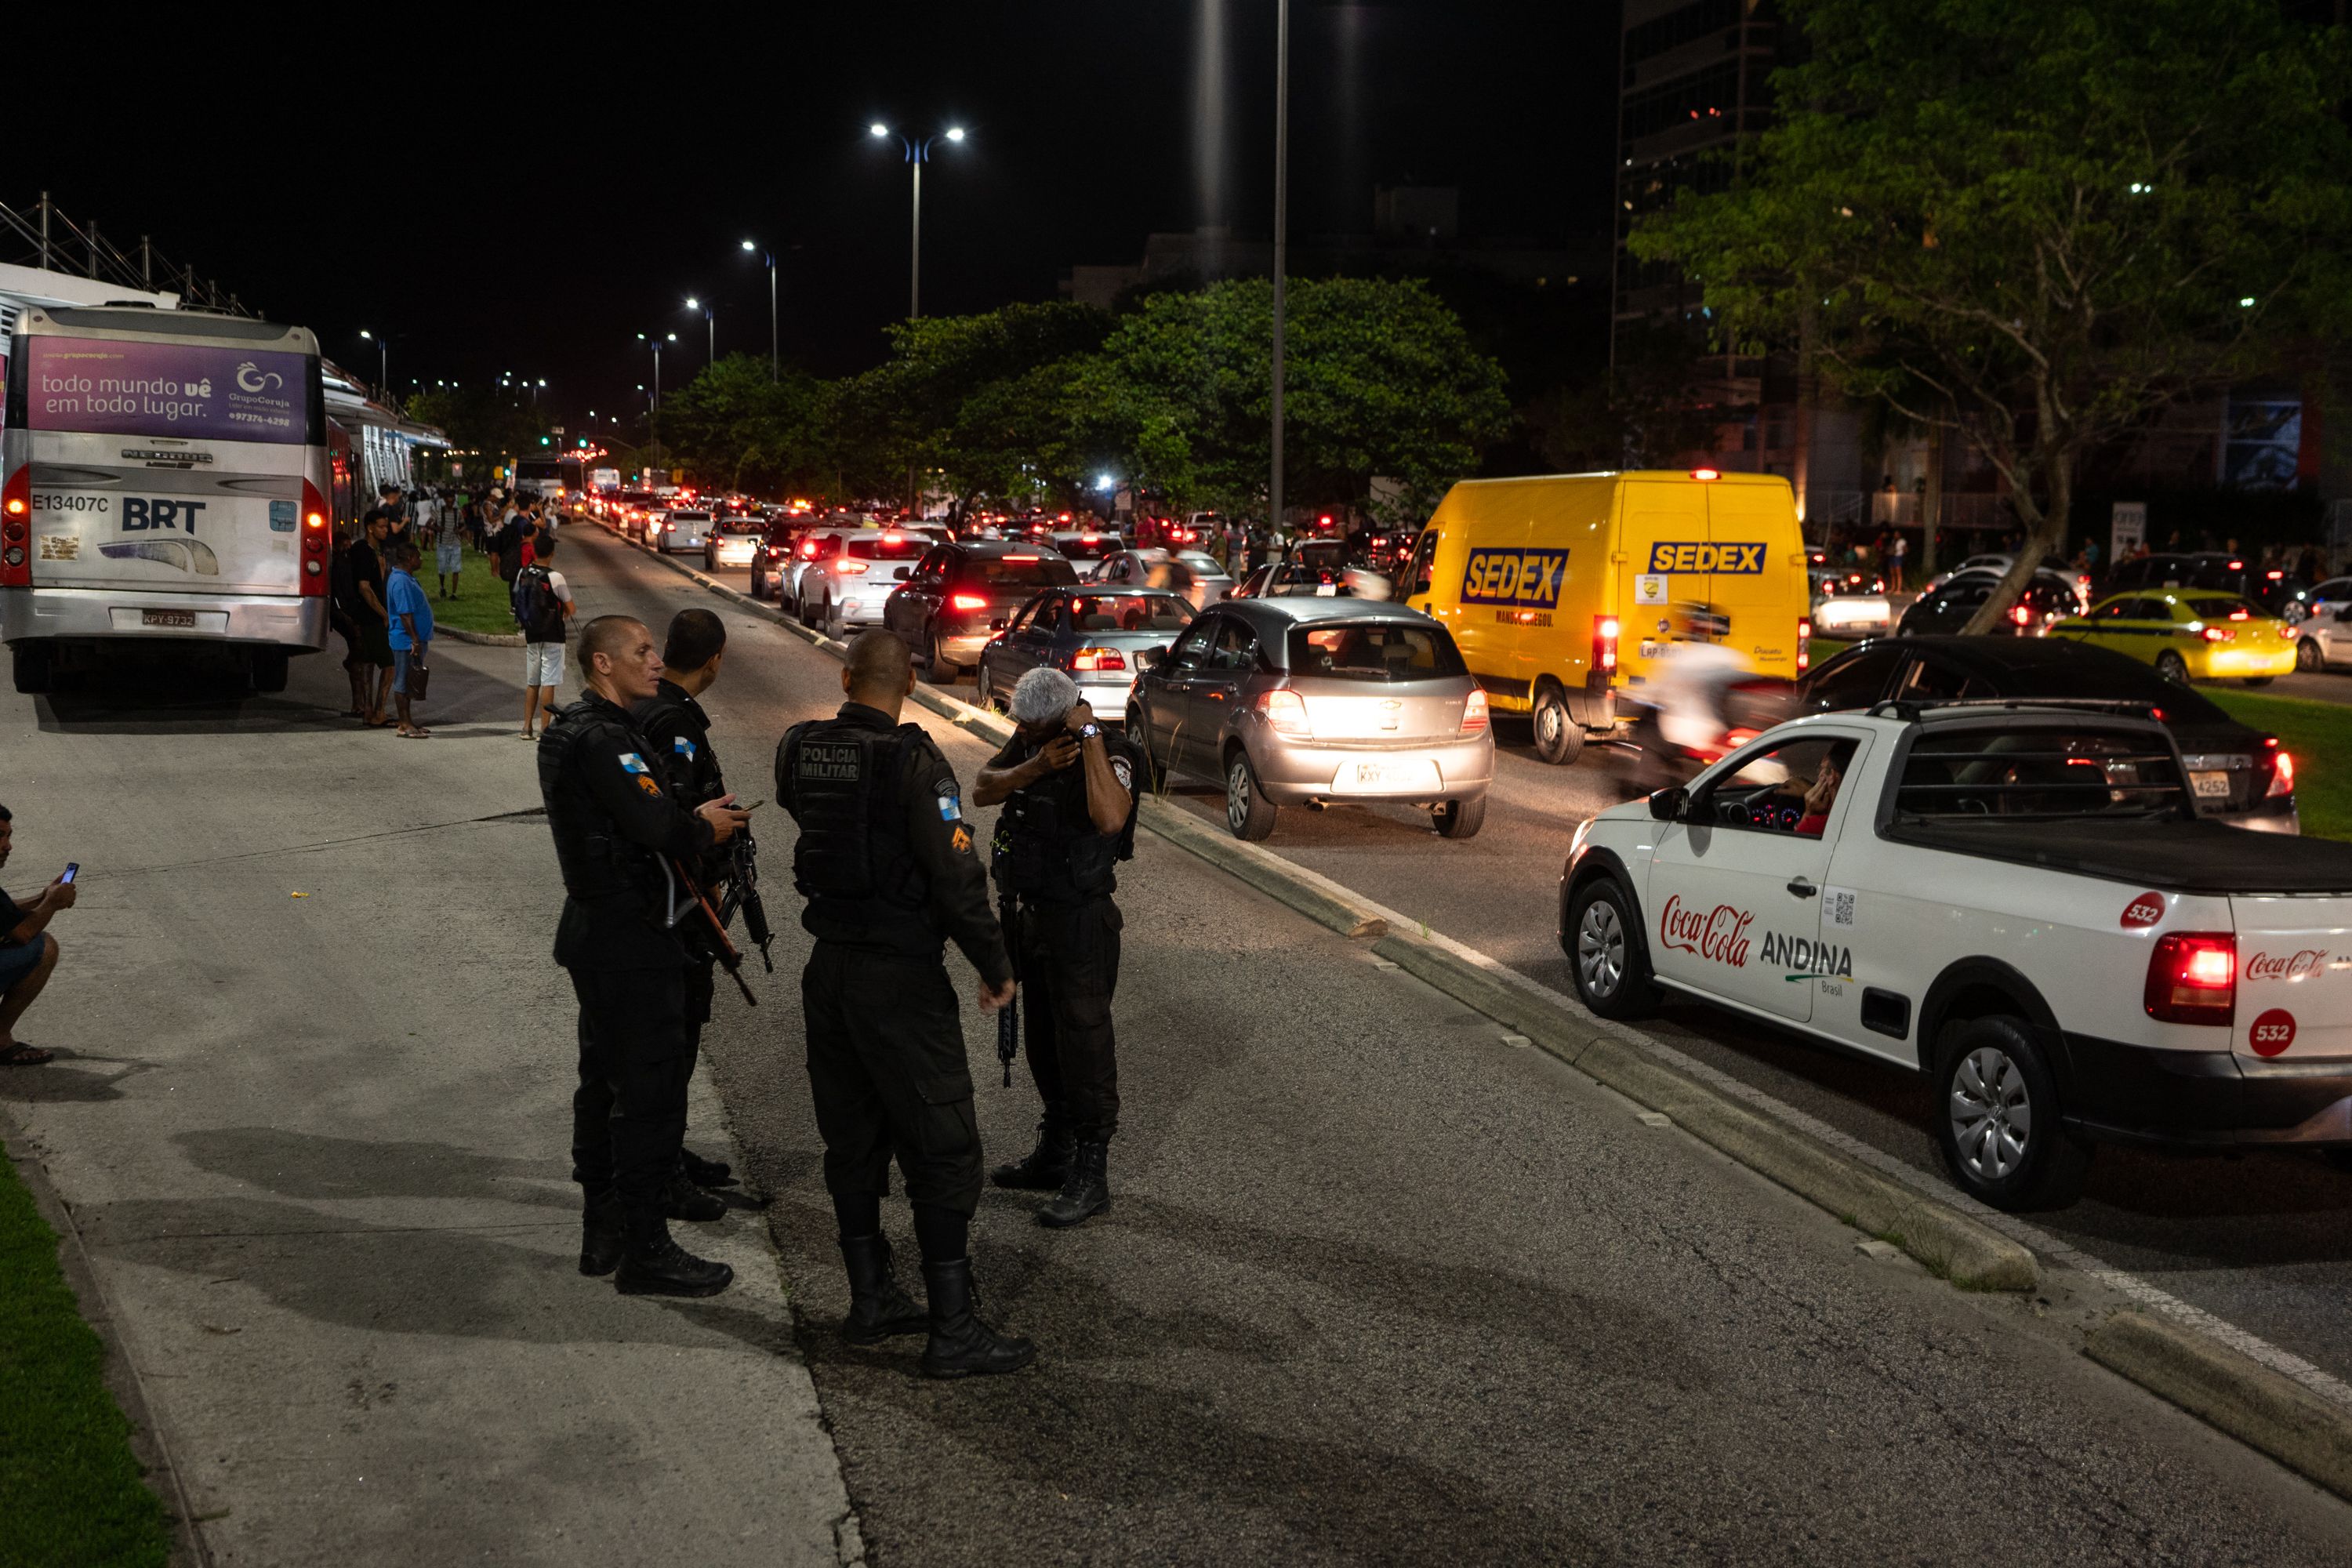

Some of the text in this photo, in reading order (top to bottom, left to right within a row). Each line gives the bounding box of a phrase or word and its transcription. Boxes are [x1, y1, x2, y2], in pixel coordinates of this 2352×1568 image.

[42, 374, 212, 398] todo mundo vê
[45, 394, 207, 421] em todo lugar.
[229, 393, 290, 408] GrupoCoruja
[235, 412, 290, 426] 97374-4298
[32, 495, 109, 513] E13407C
[122, 497, 206, 535] BRT
[1653, 544, 1762, 572] SEDEX
[1465, 554, 1563, 602] SEDEX
[802, 746, 857, 763] POLÍCIA
[801, 762, 858, 779] MILITAR
[1360, 771, 1381, 782] KXY
[2127, 904, 2158, 923] 532
[1661, 895, 1755, 968] Coca-Cola
[1760, 930, 1853, 978] ANDINA
[2245, 949, 2330, 980] Coca-Cola
[1821, 980, 1843, 997] Brasil
[2256, 1025, 2290, 1041] 532
